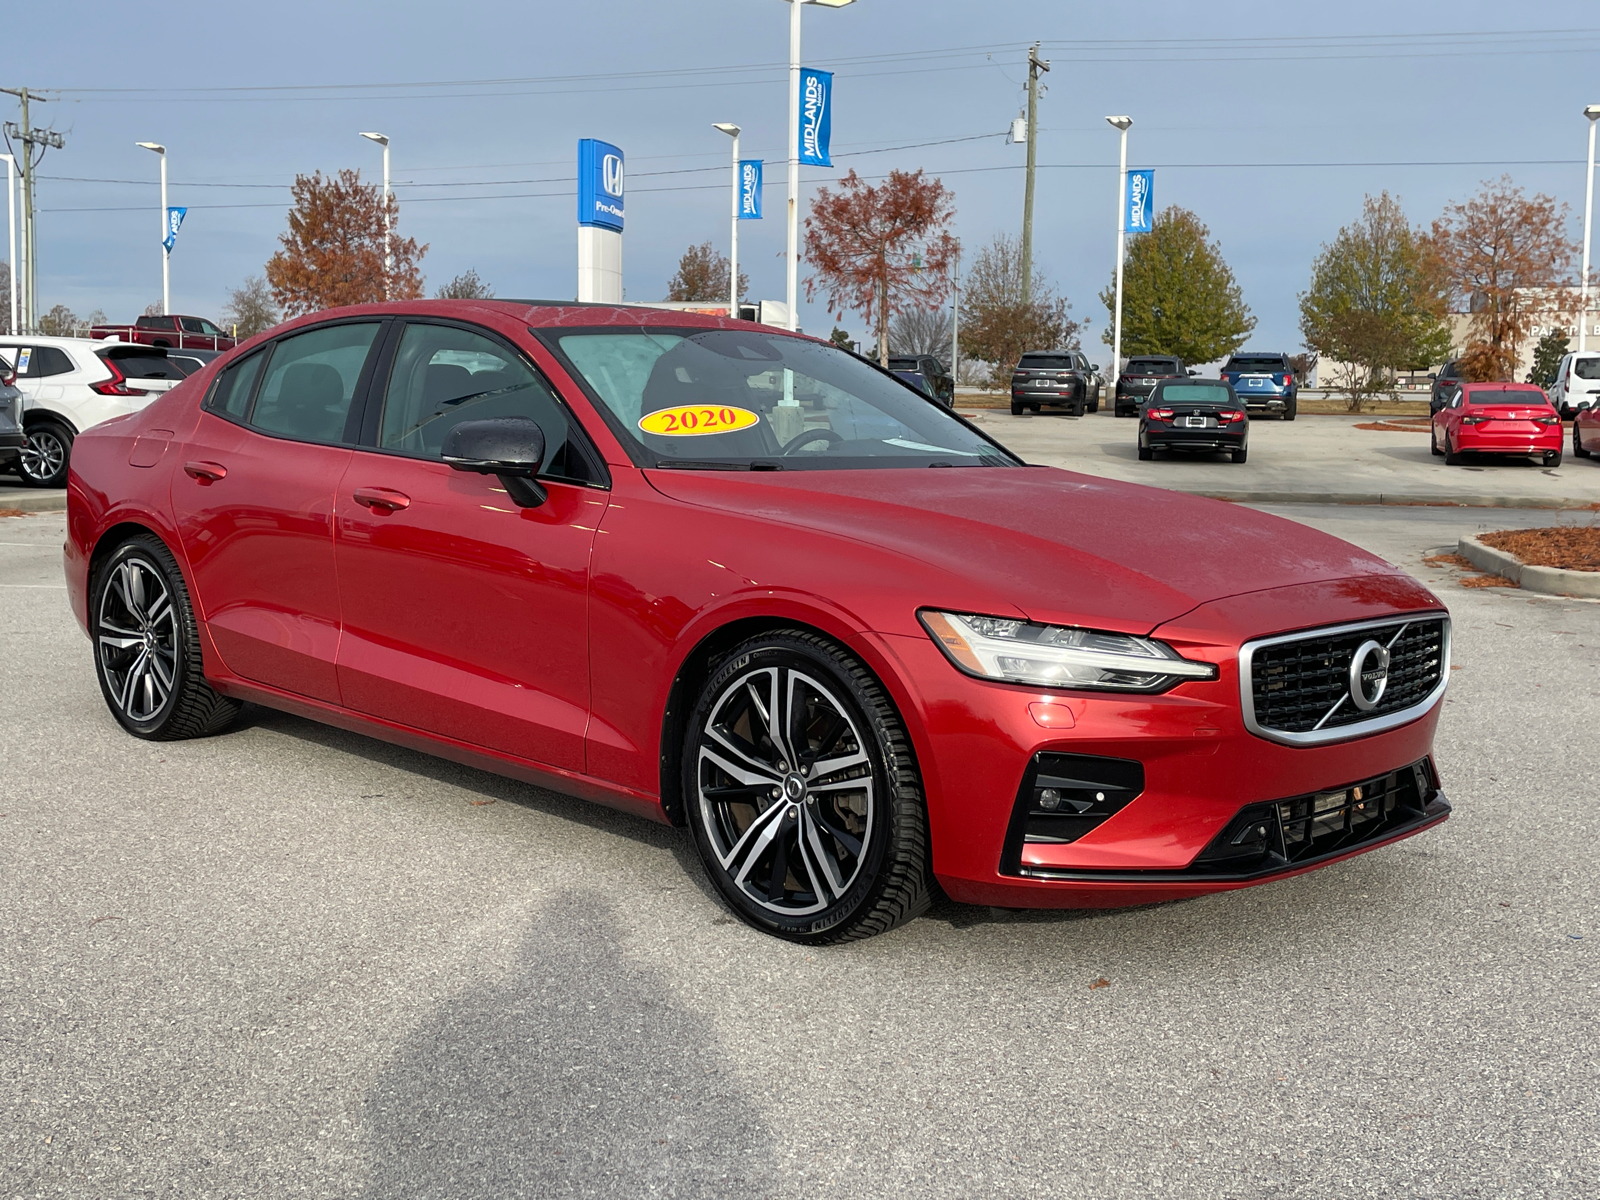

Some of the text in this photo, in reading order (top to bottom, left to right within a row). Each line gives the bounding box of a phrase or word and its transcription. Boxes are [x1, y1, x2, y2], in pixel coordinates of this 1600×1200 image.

[804, 76, 818, 157] MIDLANDS
[743, 164, 752, 214] MIDLANDS
[1131, 174, 1142, 227] MIDLANDS
[661, 408, 736, 433] 2020
[706, 655, 748, 698] MICHELIN
[1361, 670, 1386, 681] VOLVO
[814, 891, 861, 931] MICHELIN
